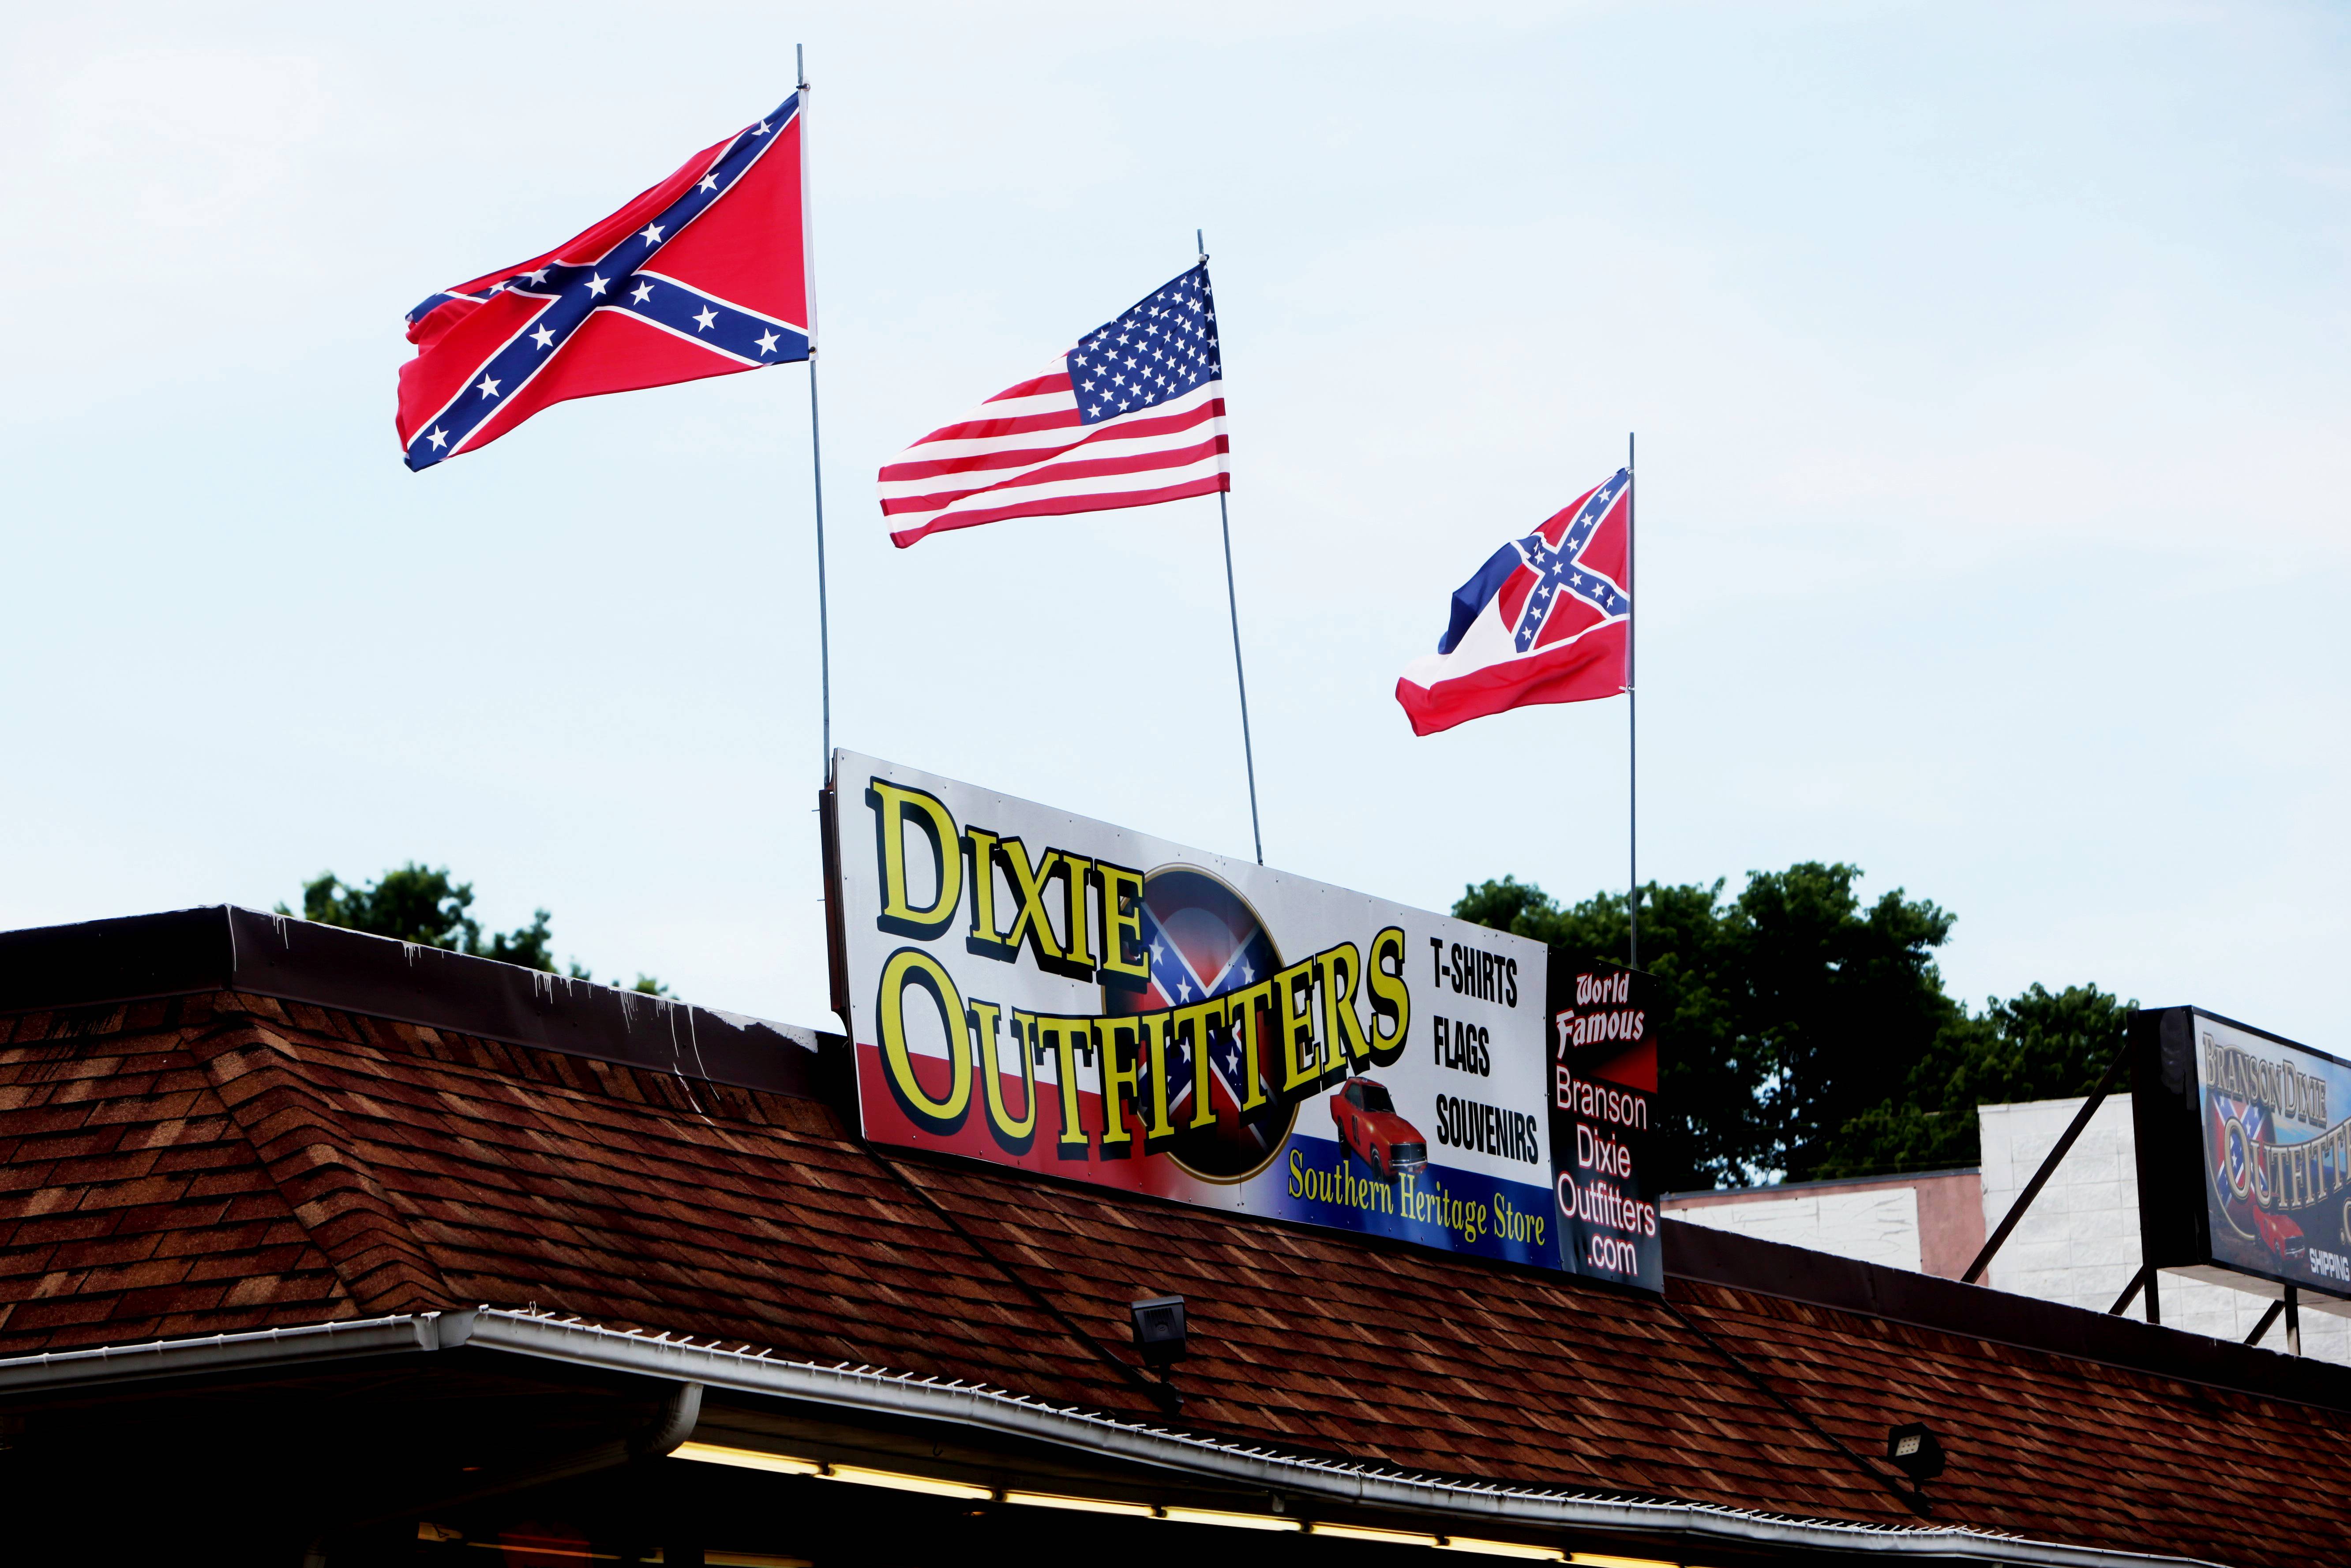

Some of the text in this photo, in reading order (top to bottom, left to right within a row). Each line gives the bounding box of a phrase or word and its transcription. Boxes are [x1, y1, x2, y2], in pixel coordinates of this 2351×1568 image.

[866, 776, 1150, 994] DIXIE
[1430, 937, 1517, 1008] T-SHIRTS
[1576, 971, 1630, 1006] World
[876, 926, 1410, 1161] OUTFITTERS
[1433, 1015, 1490, 1077] FLAGS
[1555, 1009, 1645, 1059] Famous
[1556, 1064, 1647, 1130] Branson
[2203, 1031, 2327, 1130] BRANSON DIXIE
[1436, 1093, 1539, 1164] SOUVENIRS
[1577, 1123, 1631, 1179] Dixie
[1288, 1149, 1545, 1246] Southern Heritage Store
[1558, 1172, 1656, 1237] Outfitters
[1588, 1233, 1638, 1276] .com
[2309, 1248, 2350, 1282] SHIPPING
